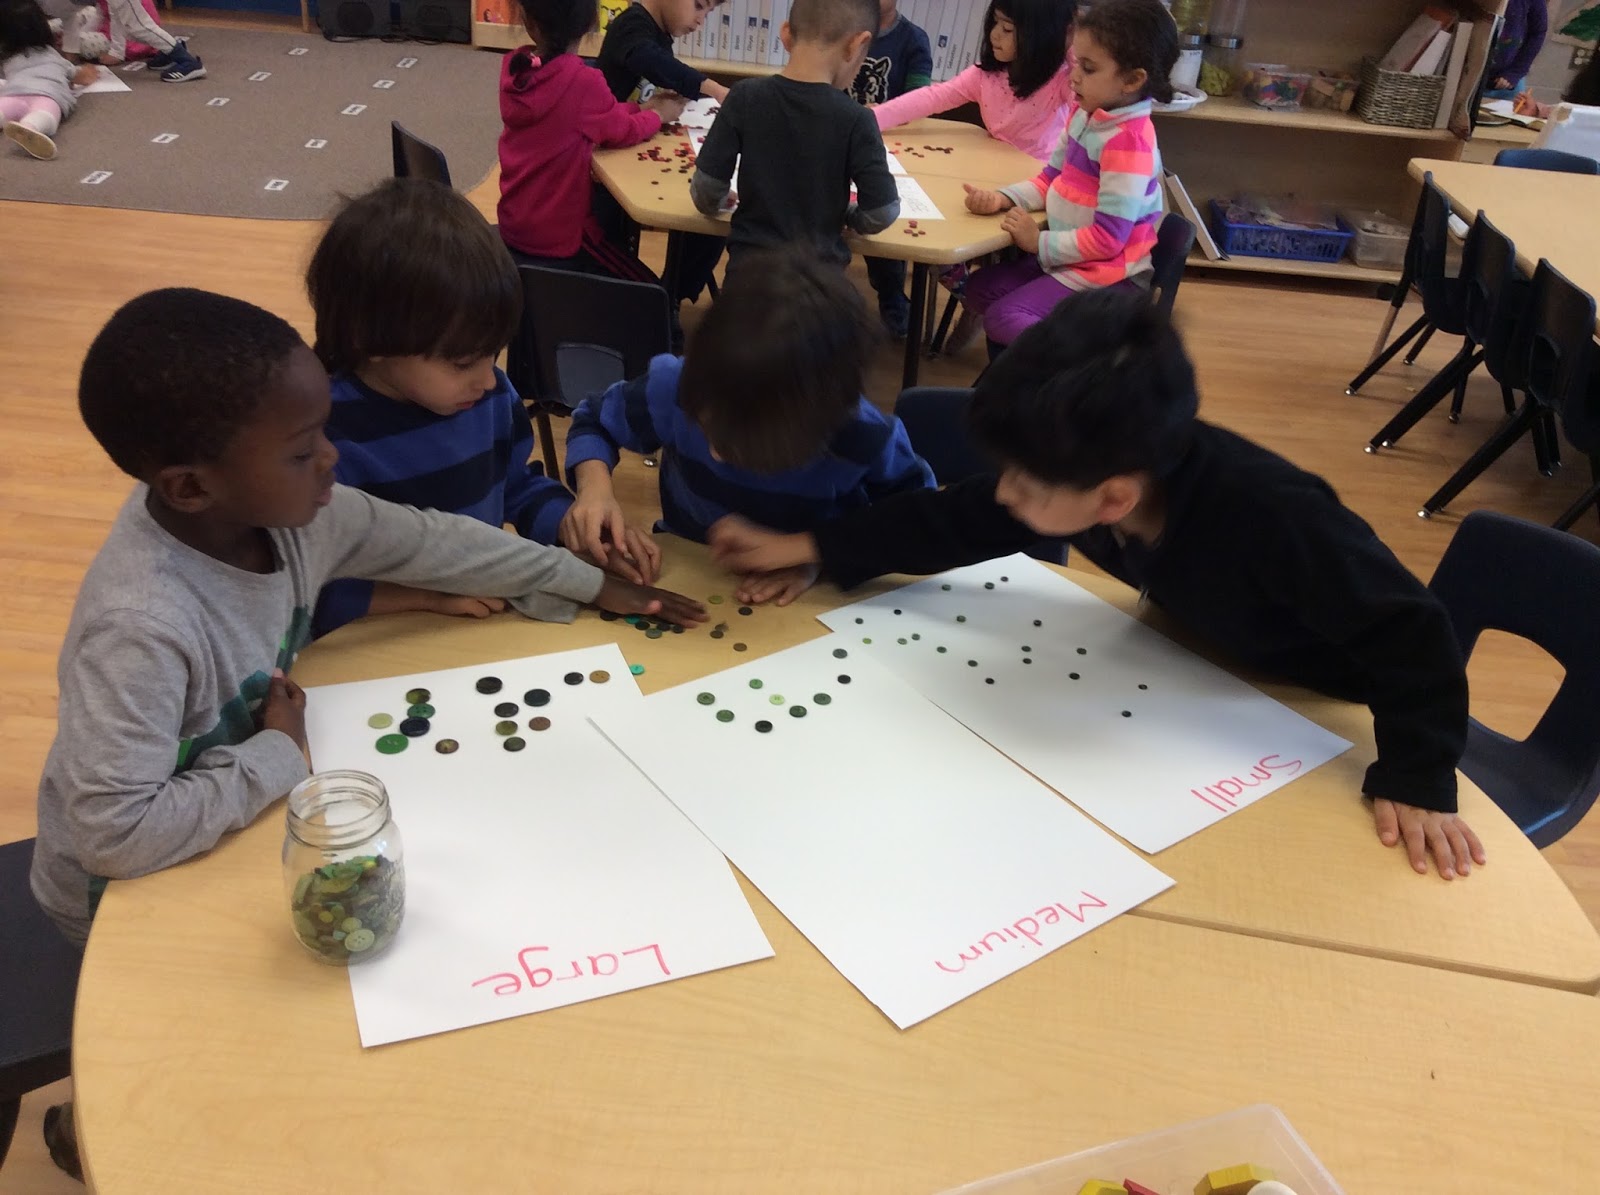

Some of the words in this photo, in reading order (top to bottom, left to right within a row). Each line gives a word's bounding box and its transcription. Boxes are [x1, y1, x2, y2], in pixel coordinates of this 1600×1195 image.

[1191, 754, 1302, 812] Small
[935, 891, 1108, 973] Medium
[472, 944, 671, 996] Large
